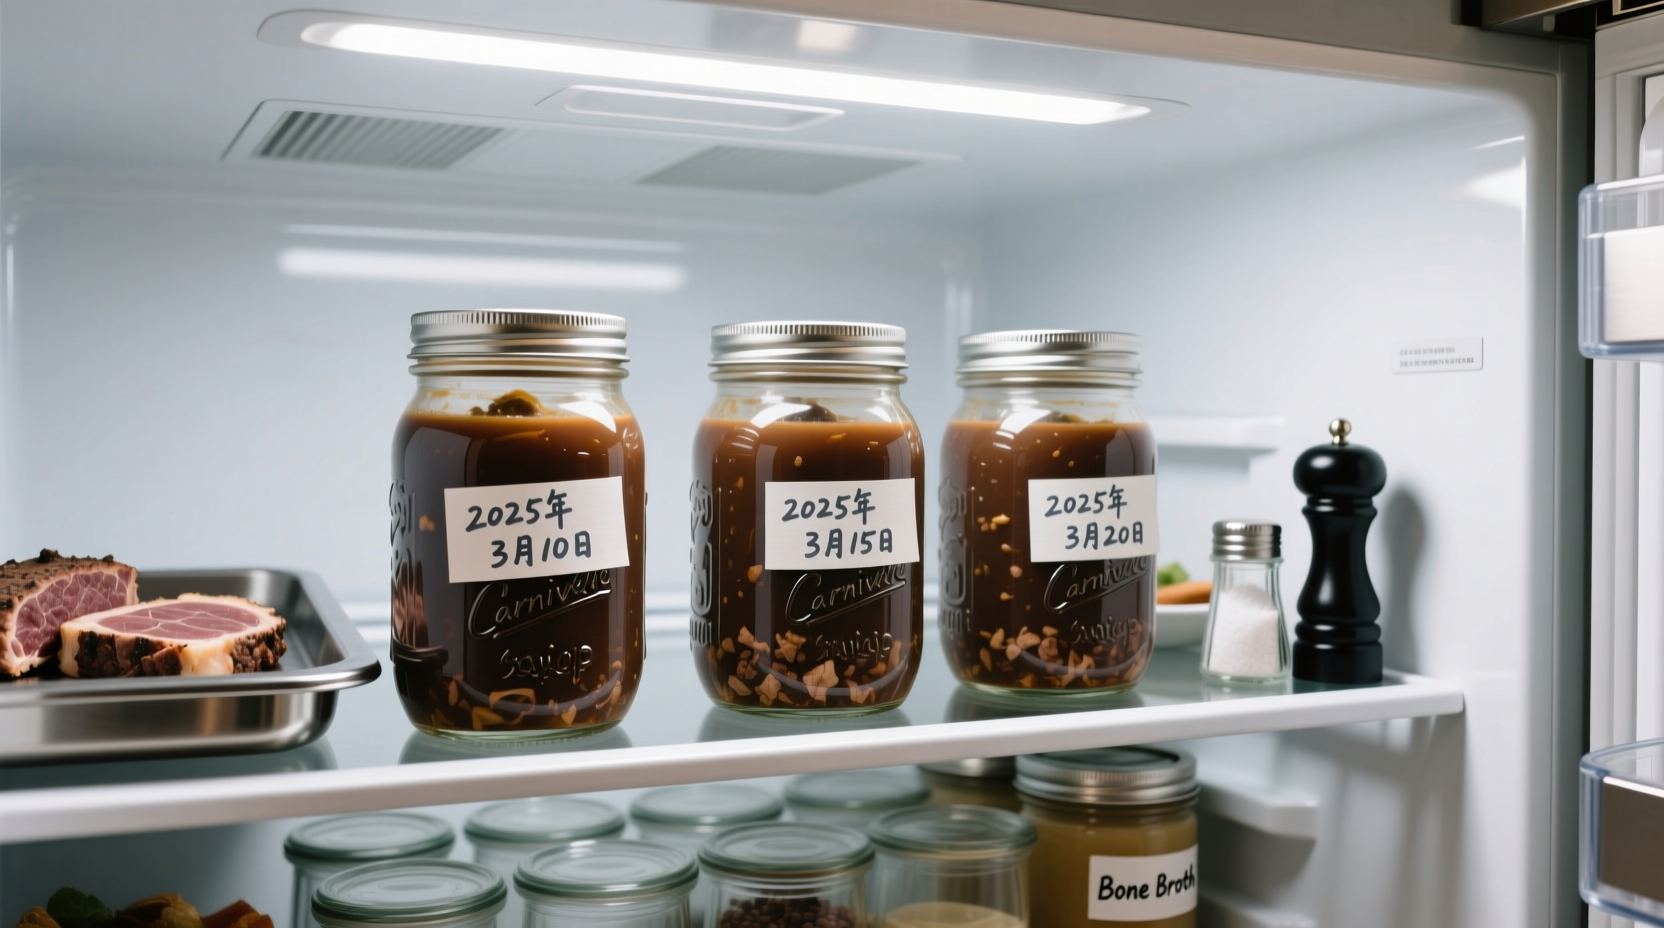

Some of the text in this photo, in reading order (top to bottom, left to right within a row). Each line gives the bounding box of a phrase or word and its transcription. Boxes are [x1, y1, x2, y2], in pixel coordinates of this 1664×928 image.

[465, 488, 573, 533] 2025年
[781, 488, 876, 525] 2025年
[1044, 484, 1128, 519] 2025年
[491, 530, 592, 569] 3月10日
[804, 527, 893, 559] 3月15日
[1064, 521, 1144, 550] 3月20日
[1098, 863, 1196, 901] Bone Broth
